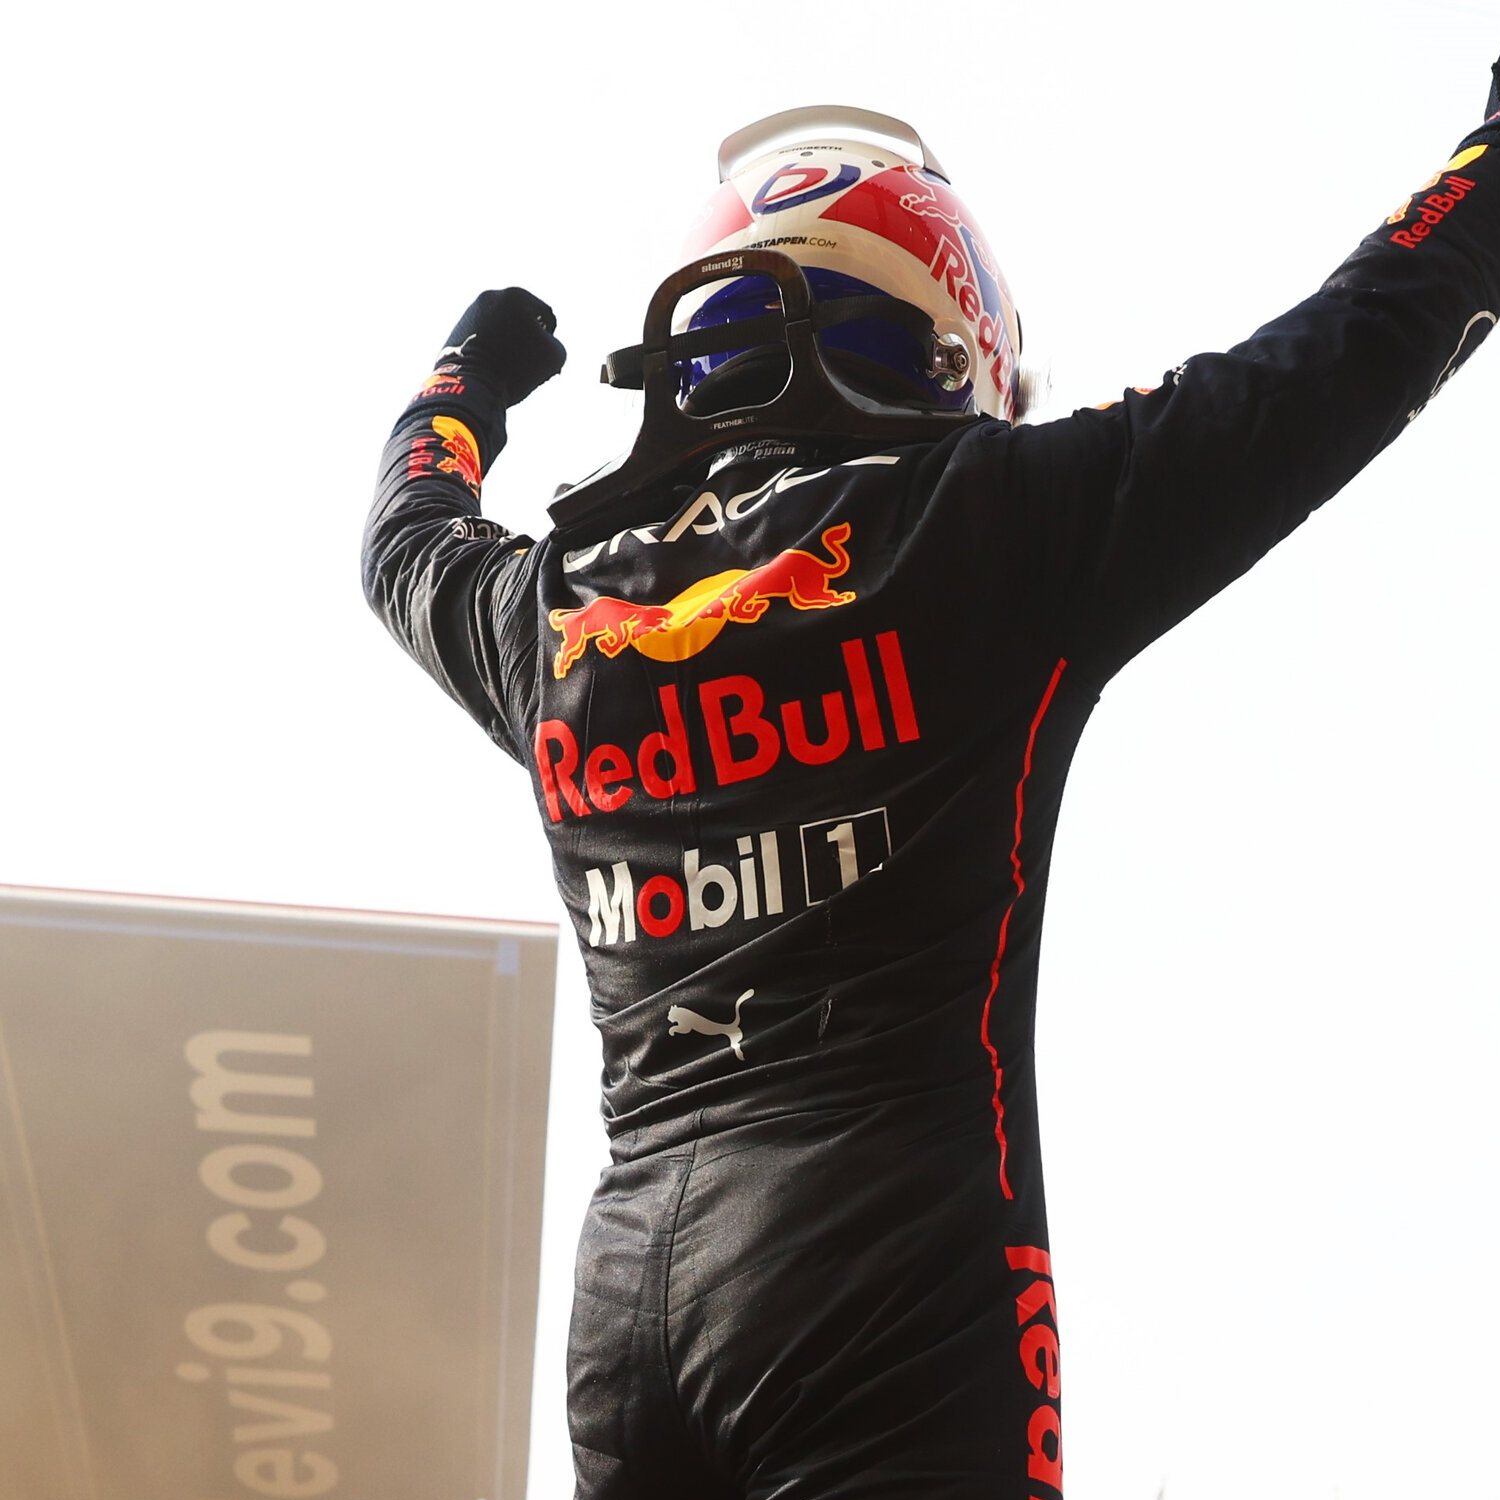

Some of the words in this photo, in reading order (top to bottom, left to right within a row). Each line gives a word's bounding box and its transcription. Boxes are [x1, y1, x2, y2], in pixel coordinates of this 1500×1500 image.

[742, 236, 837, 250] RSTAPPEN.COM
[1391, 206, 1441, 249] Red
[1428, 176, 1476, 214] Bull
[929, 234, 1003, 358] Red
[585, 830, 784, 947] Mobil
